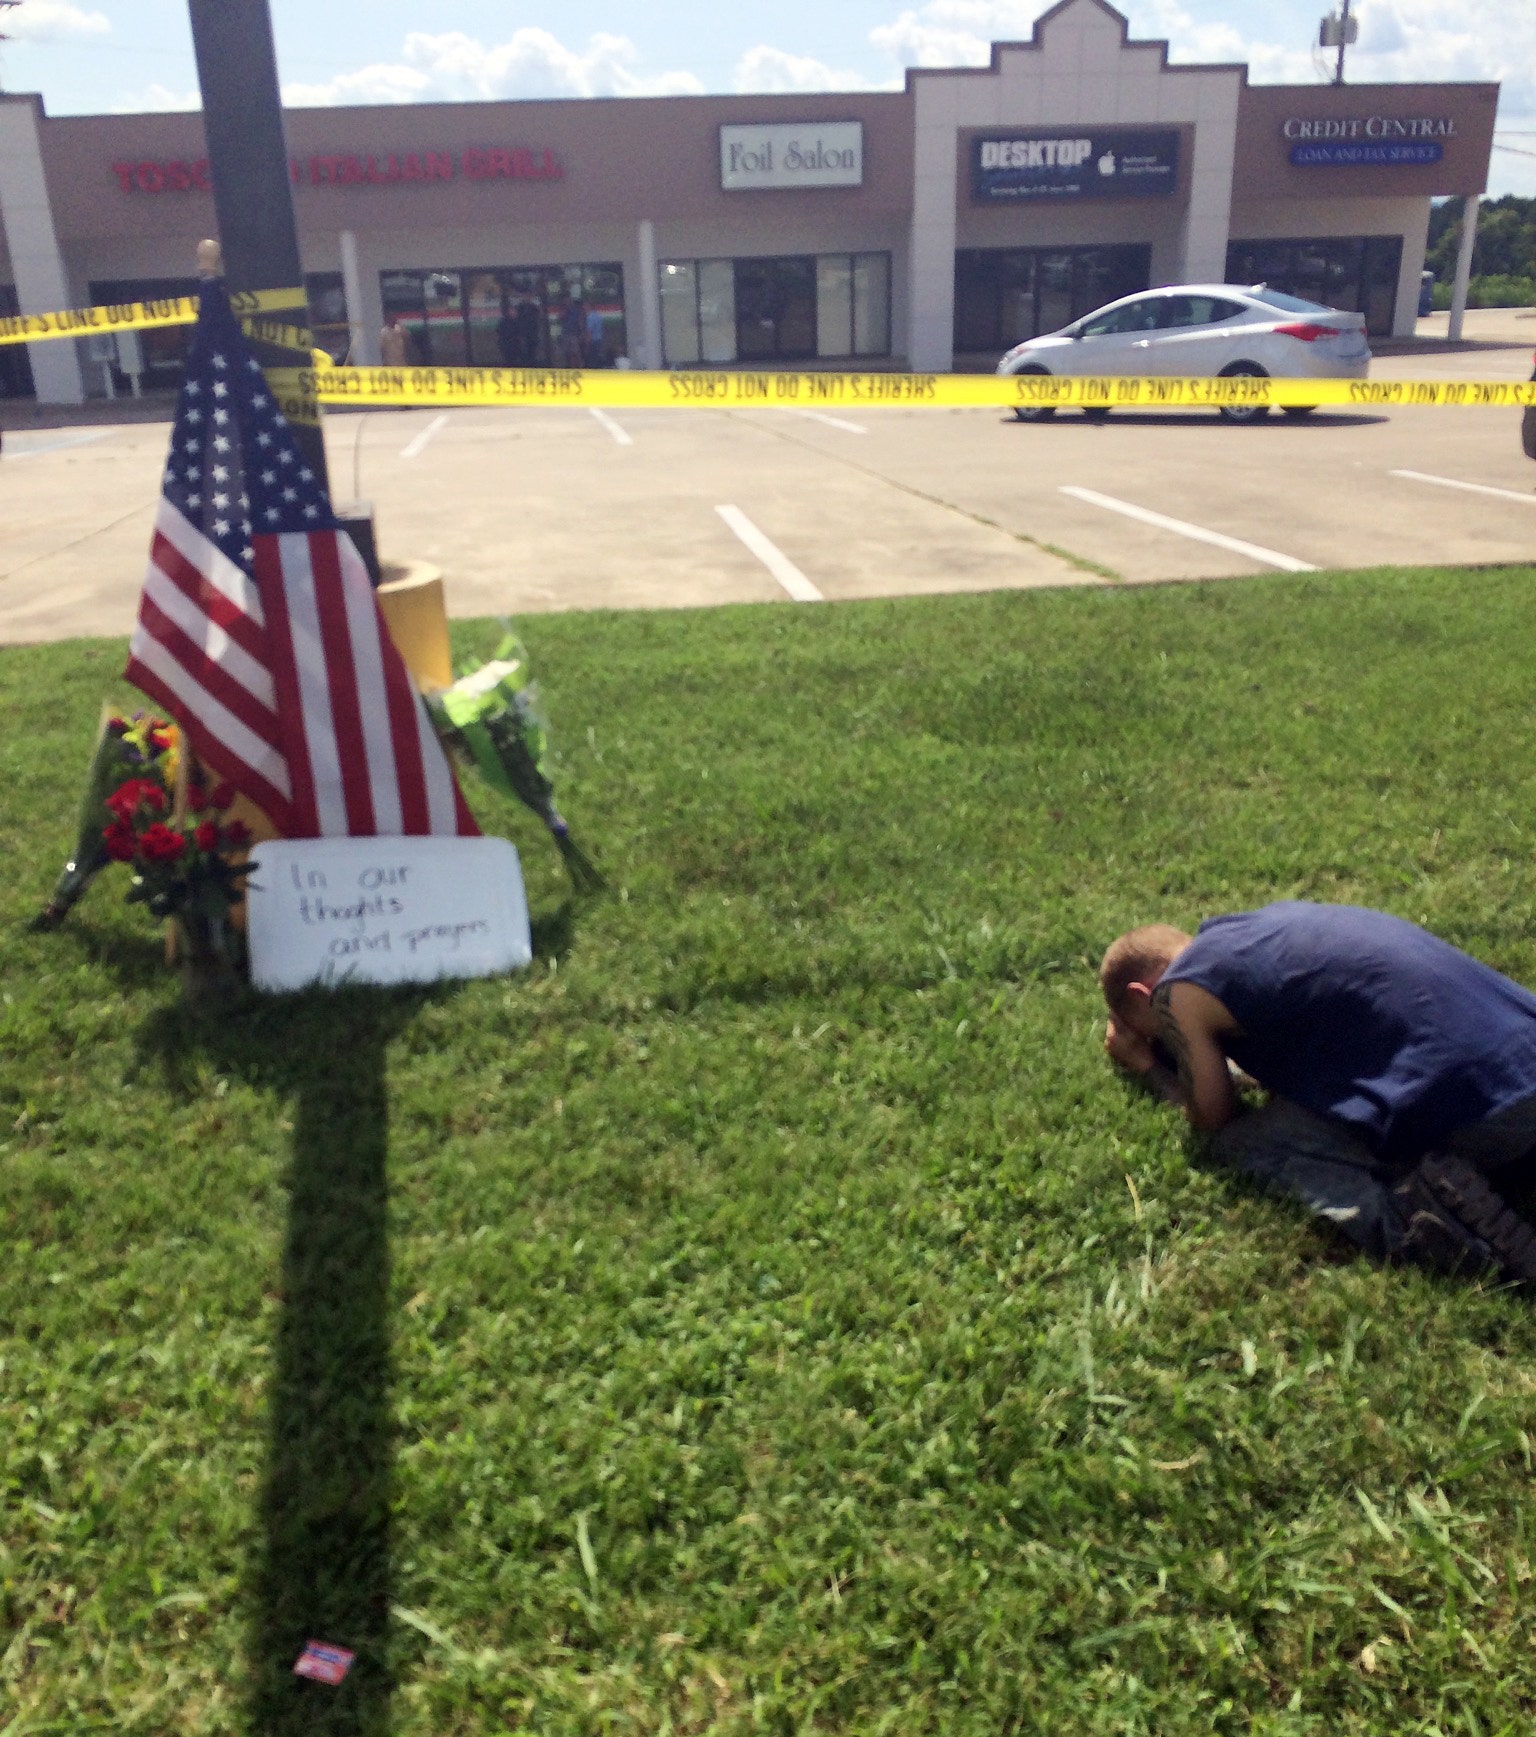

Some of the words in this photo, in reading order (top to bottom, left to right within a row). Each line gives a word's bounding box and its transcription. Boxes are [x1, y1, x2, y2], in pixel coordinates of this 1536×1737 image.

[1283, 117, 1361, 138] CREDIT
[1365, 116, 1457, 136] CENTRAL
[729, 140, 773, 172] Foil
[783, 138, 855, 170] Salon
[981, 138, 1092, 169] DESKTOP
[307, 151, 452, 187] ITALIAN
[461, 147, 566, 179] GRILL
[105, 303, 134, 324] DO
[142, 298, 182, 320] NOT
[368, 370, 404, 395] NOT
[410, 369, 436, 394] DO
[668, 374, 728, 399] CROSS
[735, 375, 770, 399] NOT
[774, 374, 801, 399] DO
[803, 374, 845, 399] LINE
[1015, 378, 1073, 401] CROSS
[1077, 379, 1112, 401] NOT
[1116, 379, 1141, 401] DO
[1149, 379, 1183, 401] LINE
[1350, 381, 1404, 403] CROSS
[1406, 382, 1441, 404] NOT
[1444, 382, 1468, 404] DO
[1471, 382, 1509, 404] LINE
[290, 864, 328, 890] In
[357, 864, 409, 890] our
[328, 930, 391, 955] and
